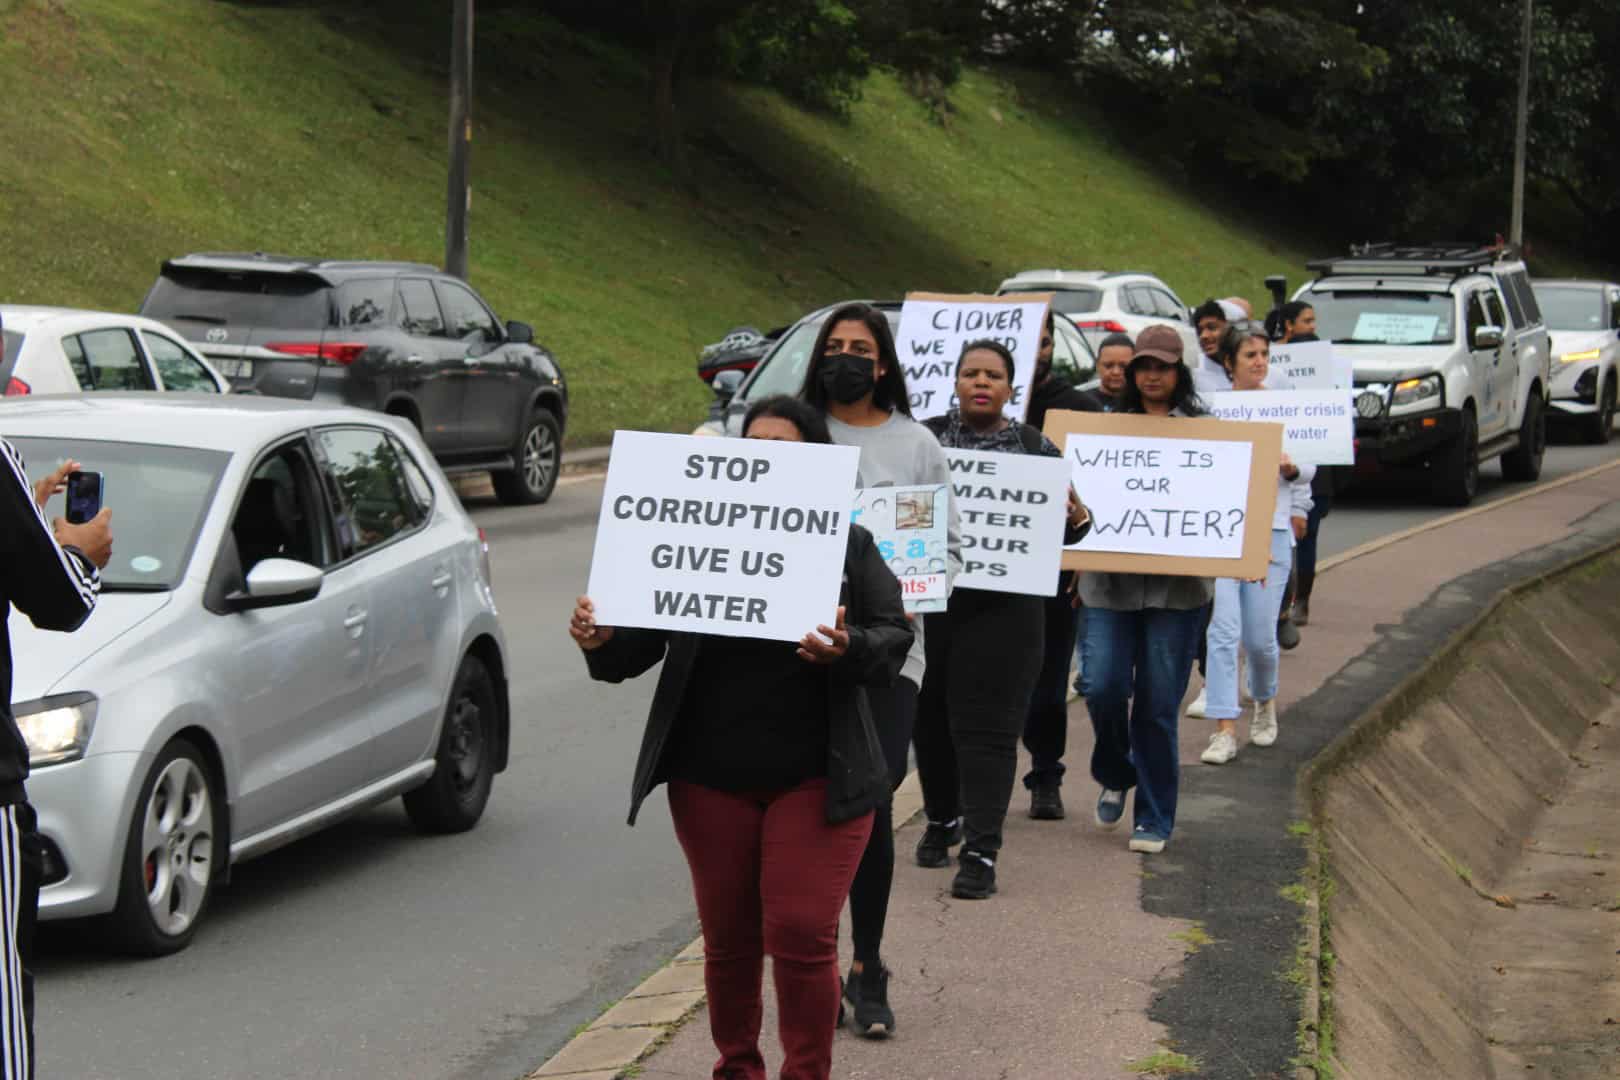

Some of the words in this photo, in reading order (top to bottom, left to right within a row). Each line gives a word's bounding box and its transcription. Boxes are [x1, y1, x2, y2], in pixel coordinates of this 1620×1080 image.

[911, 339, 945, 356] WE
[1271, 353, 1291, 364] AYS
[901, 361, 955, 380] WAT
[1287, 367, 1316, 377] ATER
[911, 390, 936, 409] OT
[1214, 405, 1253, 421] osely
[1258, 406, 1299, 417] water
[1304, 404, 1345, 416] crisis
[1287, 428, 1329, 440] water
[947, 458, 997, 475] WE
[1074, 447, 1161, 468] WHERE
[1179, 450, 1214, 468] IS
[684, 454, 770, 483] STOP
[952, 484, 1049, 505] MAND
[1125, 478, 1171, 495] OUR
[613, 495, 840, 535] CORRUPTION!
[959, 510, 1032, 529] TER
[1088, 508, 1245, 539] WATER?
[651, 544, 730, 573] GIVE
[740, 551, 785, 578] US
[961, 560, 1009, 577] PS
[653, 590, 768, 624] WATER
